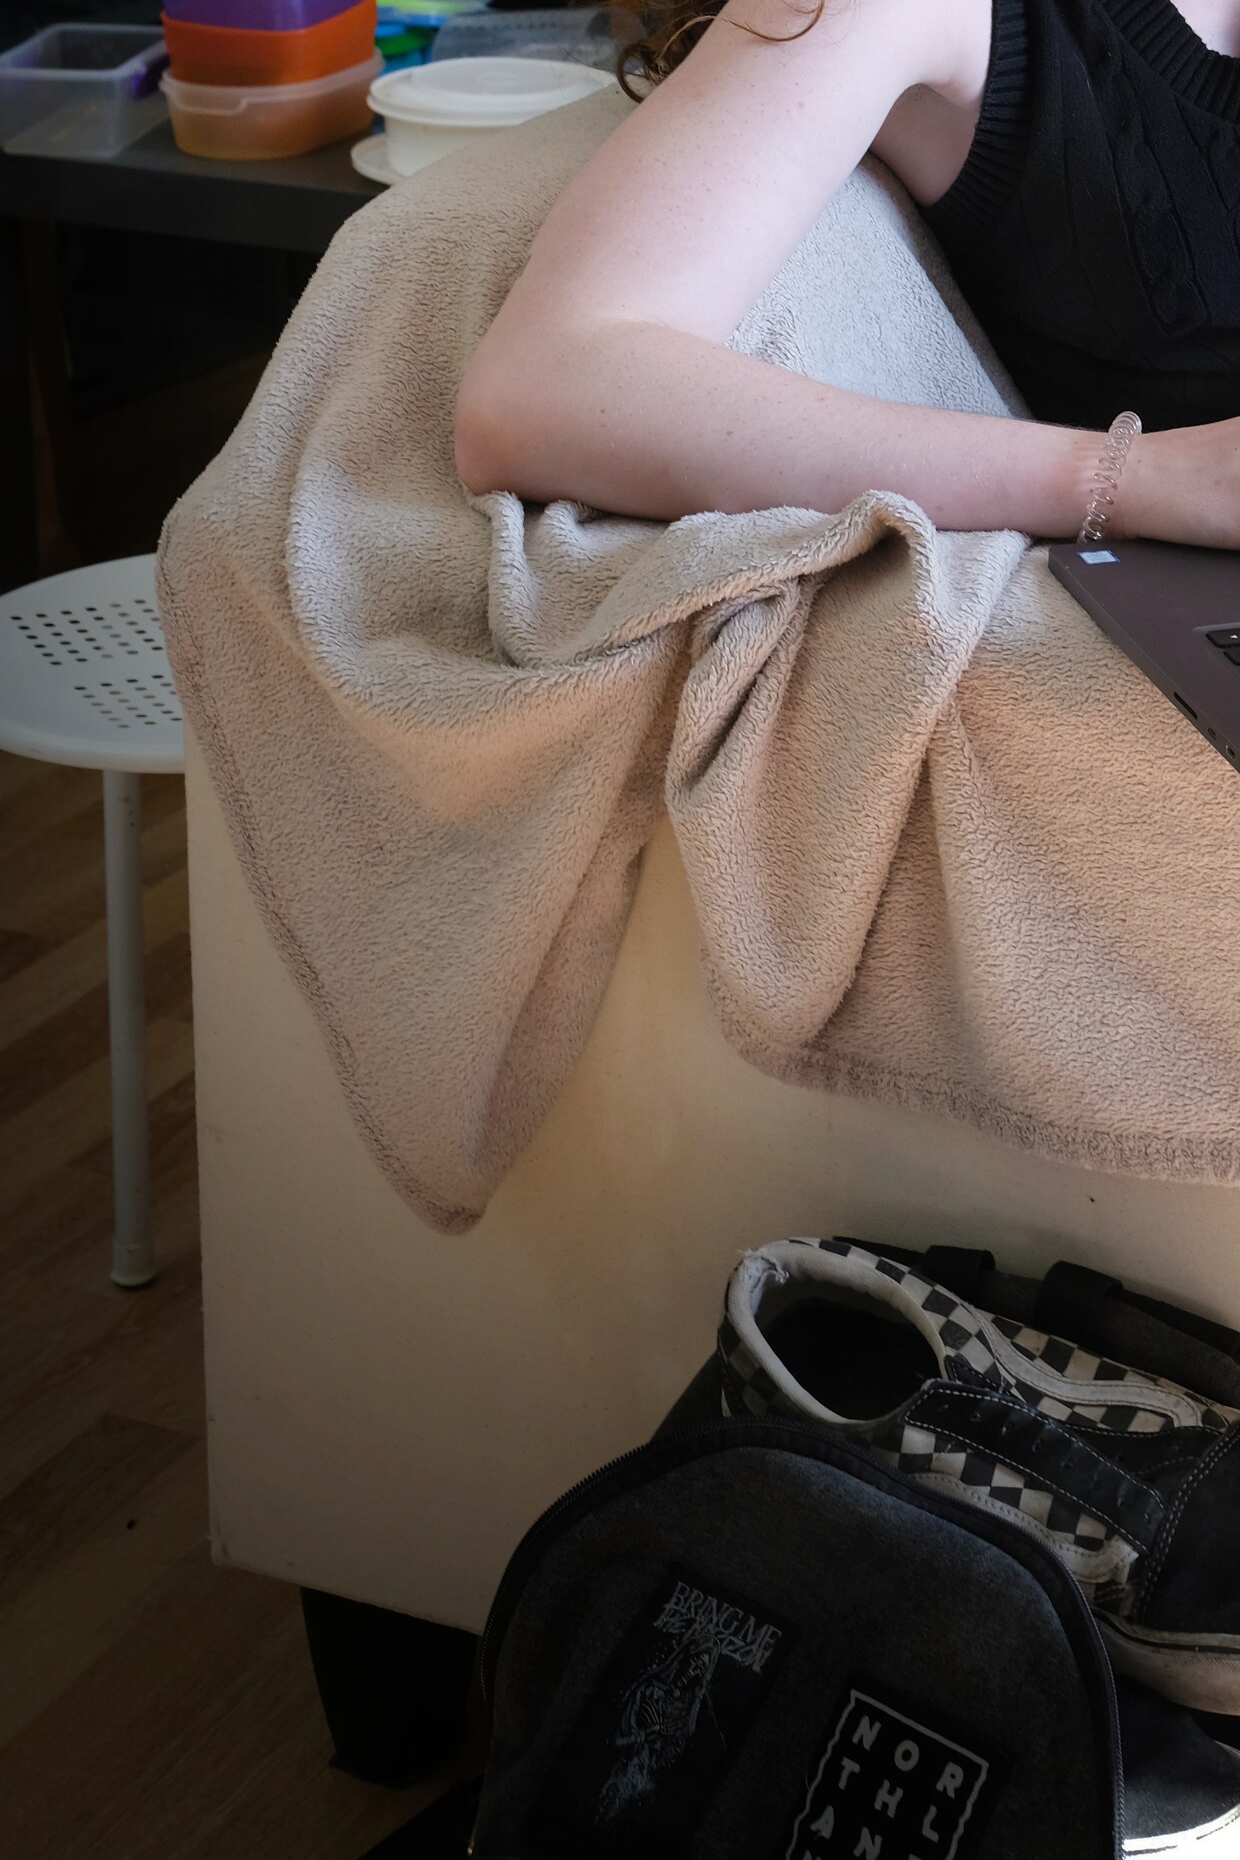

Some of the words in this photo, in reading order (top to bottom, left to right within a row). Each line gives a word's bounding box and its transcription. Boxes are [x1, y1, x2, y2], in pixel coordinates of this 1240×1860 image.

[667, 1580, 745, 1636] BRING
[741, 1614, 783, 1658] ME
[837, 1755, 940, 1844] THL
[850, 1714, 965, 1800] NOR
